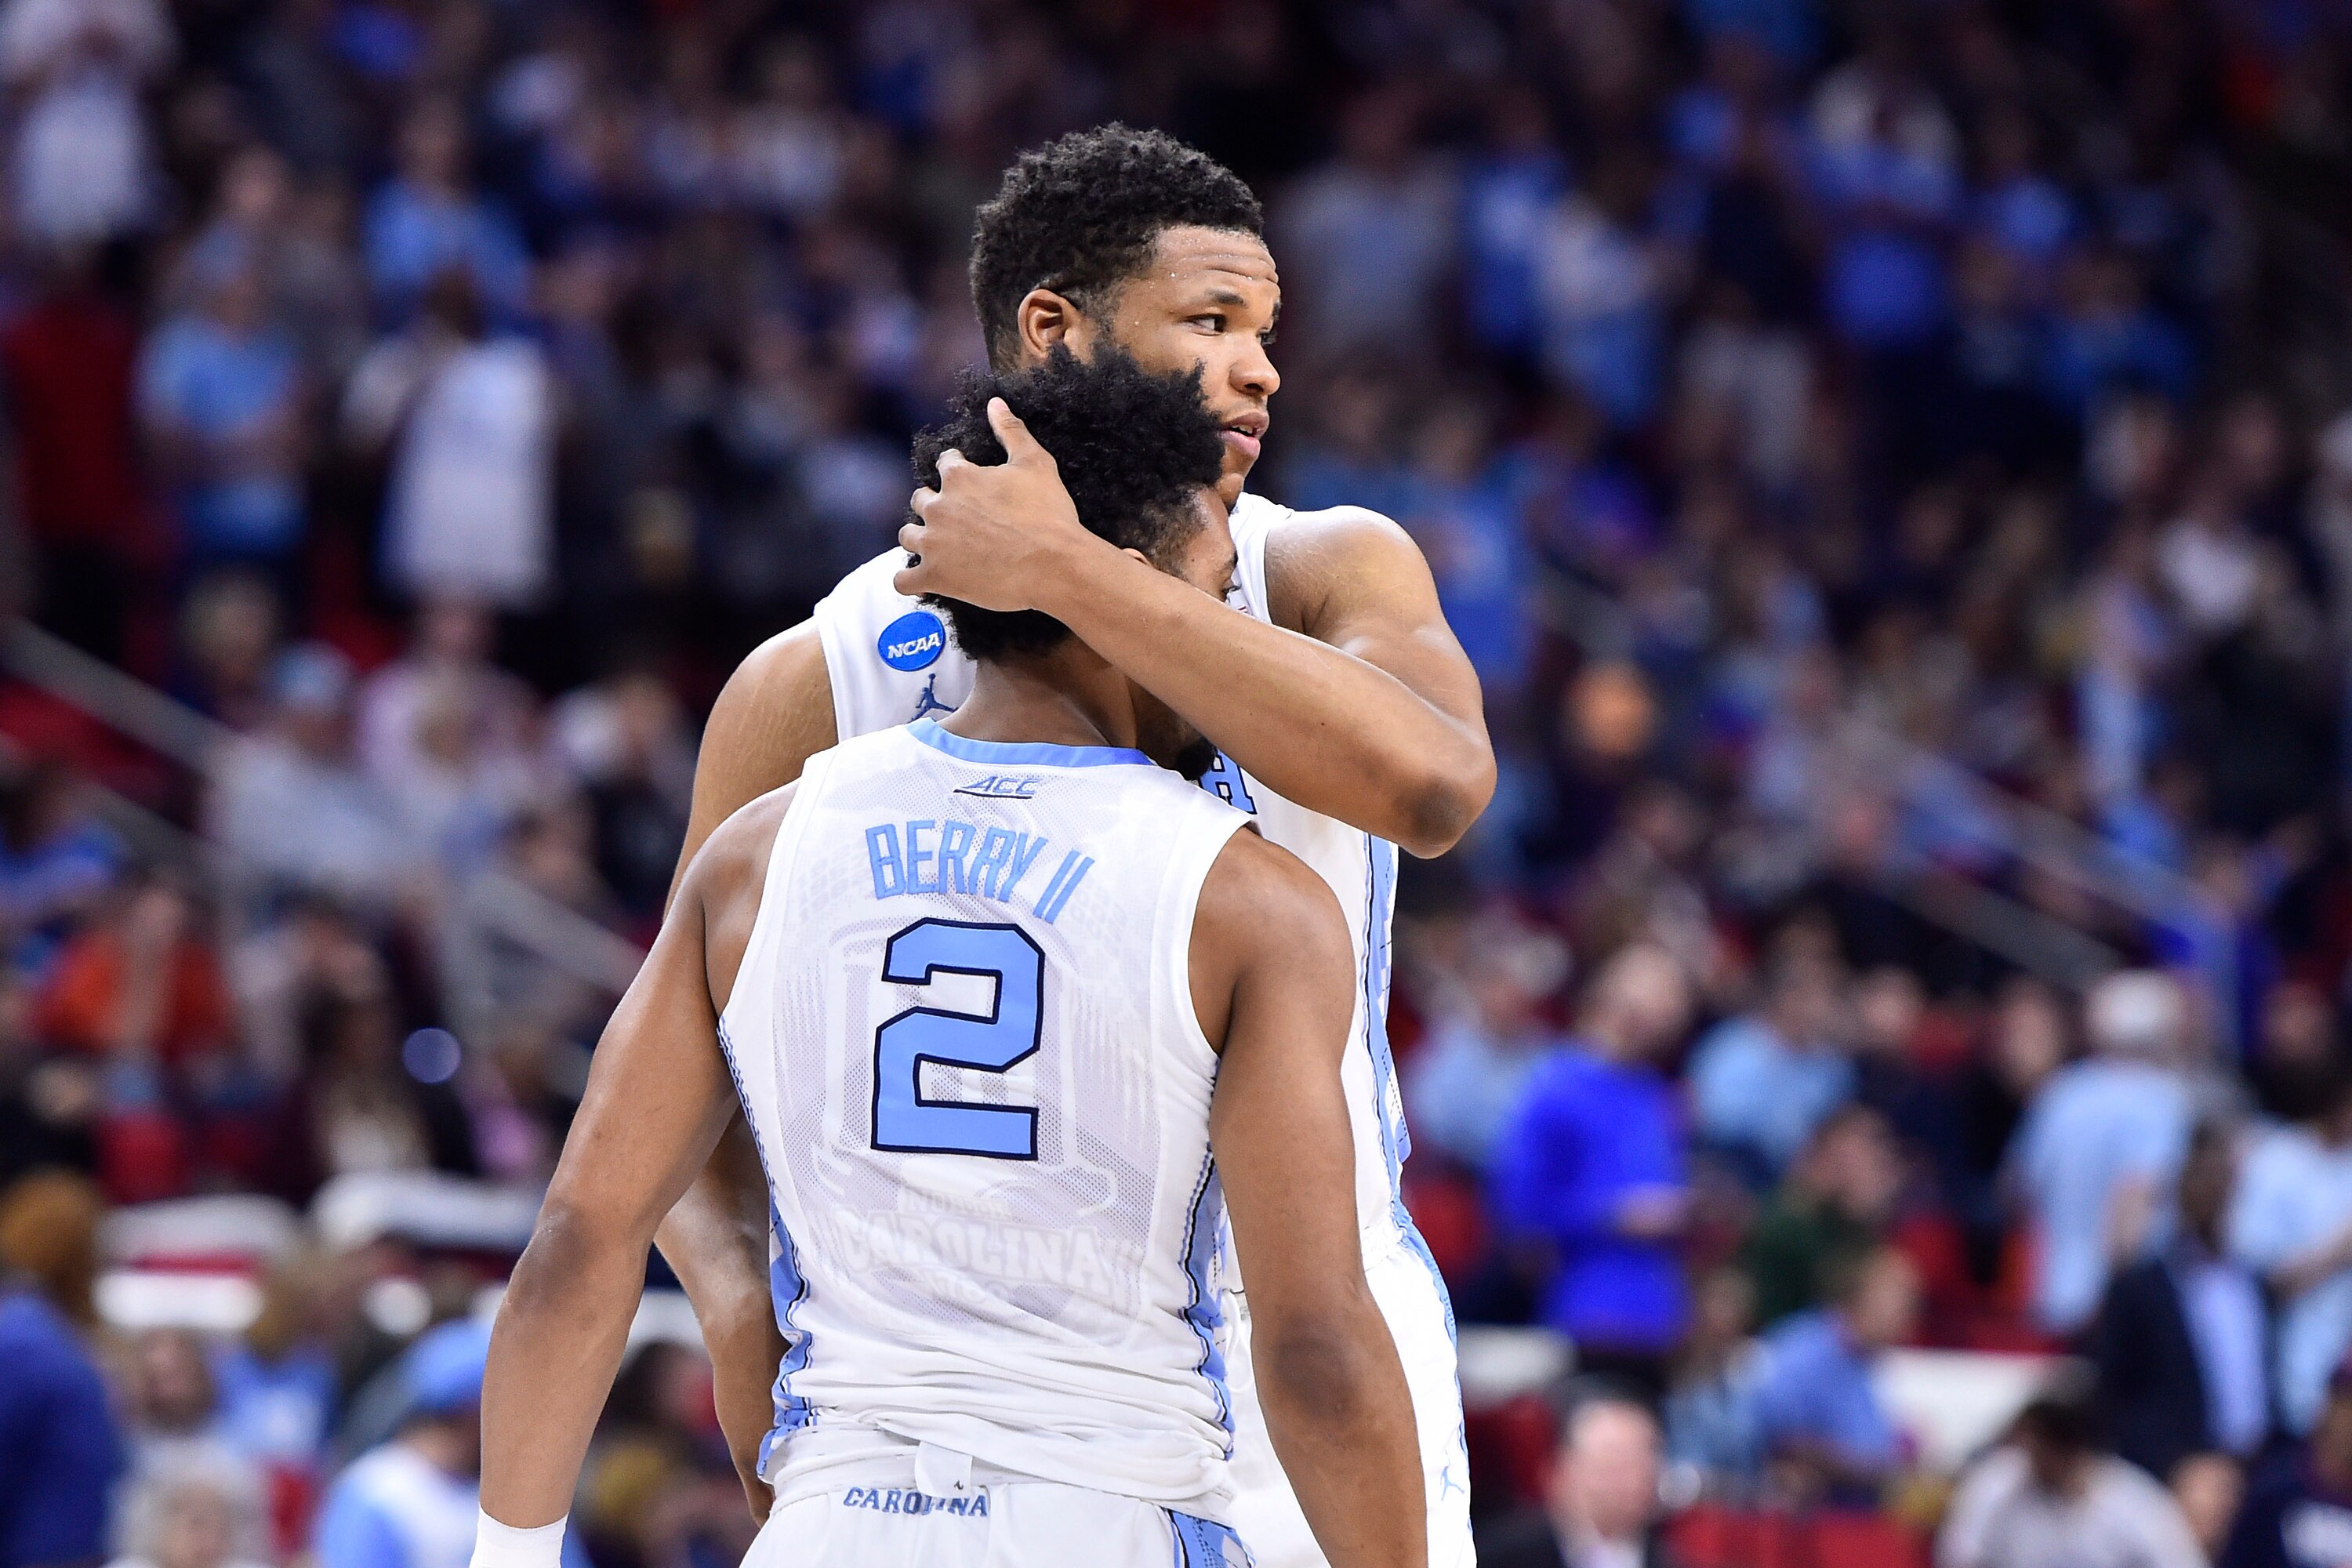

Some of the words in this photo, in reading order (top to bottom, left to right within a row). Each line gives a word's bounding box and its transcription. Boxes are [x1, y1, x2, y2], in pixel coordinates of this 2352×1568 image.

[887, 632, 941, 659] NCAA
[960, 775, 1042, 795] ACC
[865, 819, 1048, 904] BERRY
[1032, 849, 1095, 924] II
[870, 916, 1045, 1160] 2
[831, 1207, 1116, 1298] CAROLINA
